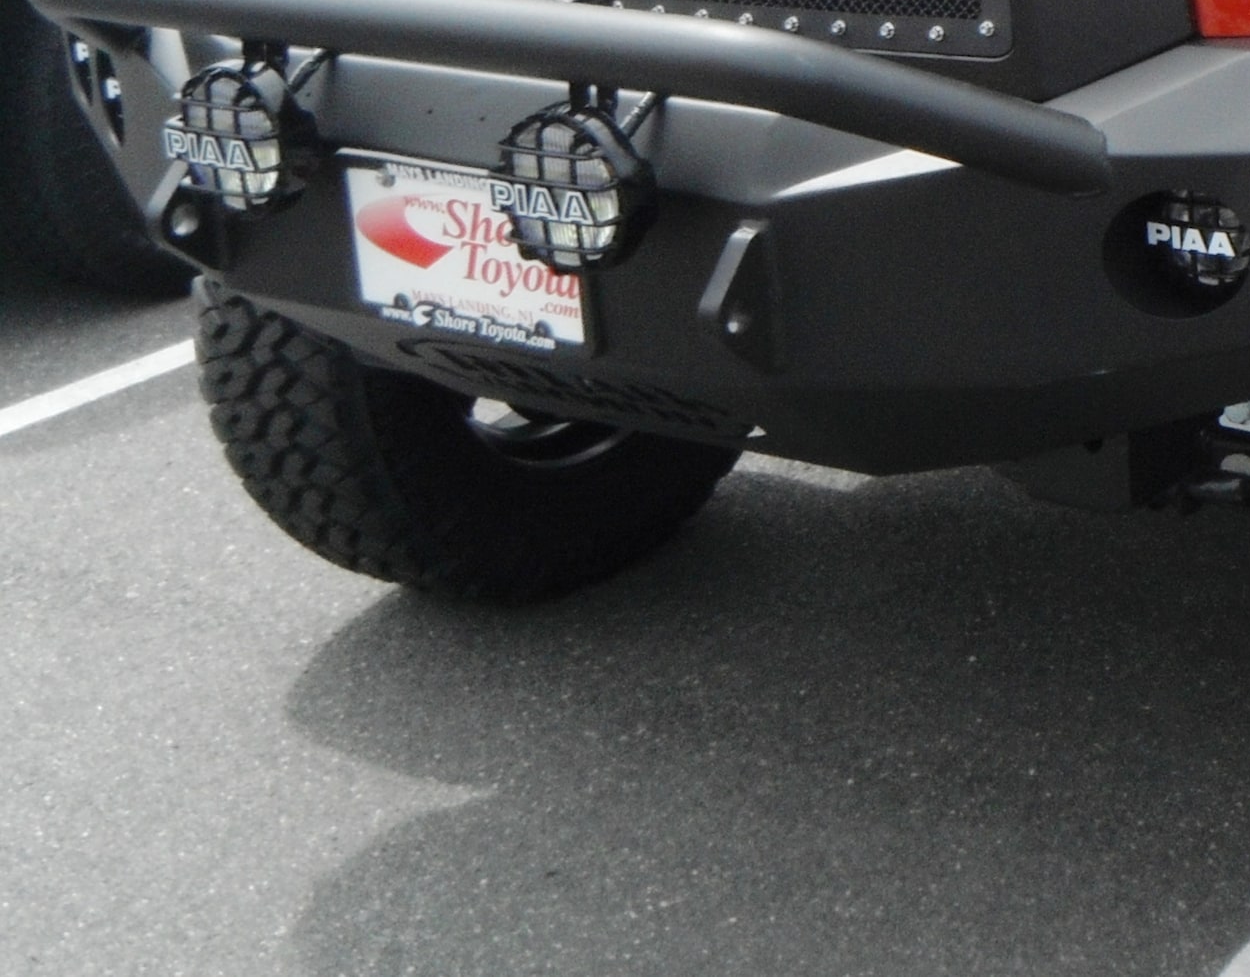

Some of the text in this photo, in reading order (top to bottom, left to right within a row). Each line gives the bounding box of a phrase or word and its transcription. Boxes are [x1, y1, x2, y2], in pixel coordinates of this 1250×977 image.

[163, 127, 256, 172] PIAA
[490, 179, 595, 224] PIAA
[1147, 221, 1236, 258] PIAA
[433, 309, 477, 333] Shore
